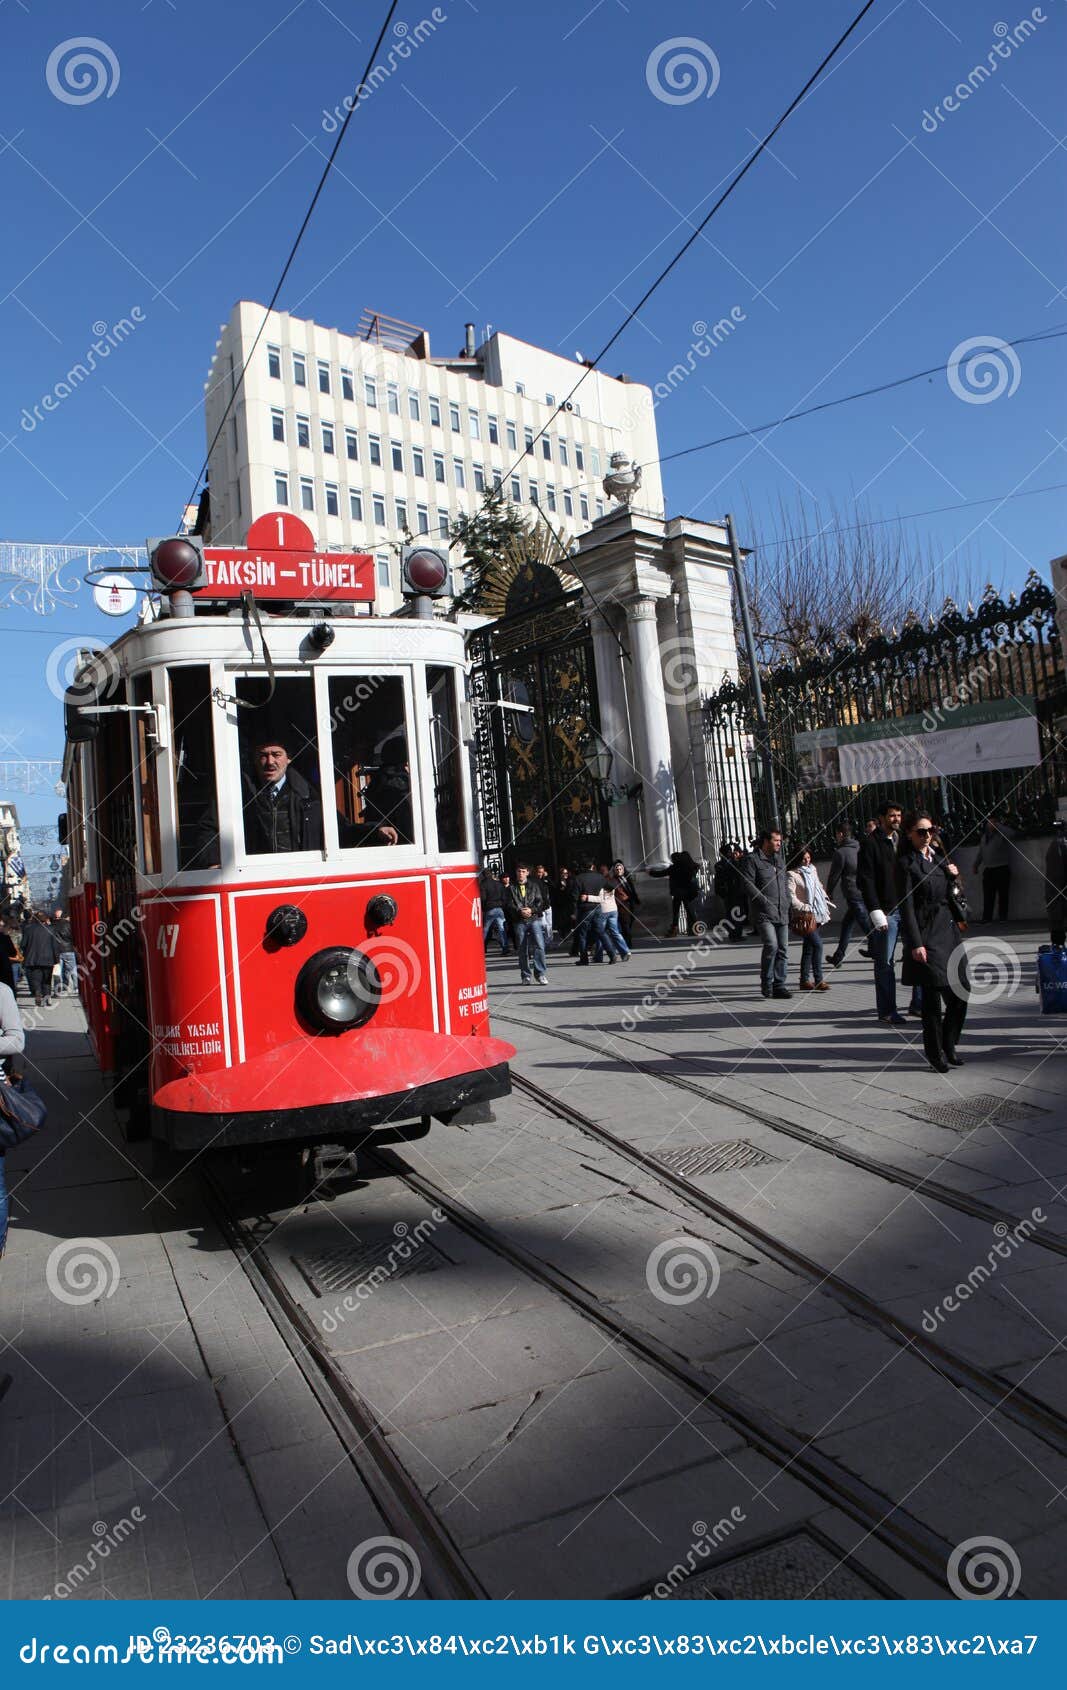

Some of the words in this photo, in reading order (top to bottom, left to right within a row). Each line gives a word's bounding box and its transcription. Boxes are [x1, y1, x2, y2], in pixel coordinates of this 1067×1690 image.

[275, 516, 285, 546] 1
[205, 556, 276, 586] TAKSİM
[298, 558, 363, 588] TÜNEL
[157, 924, 180, 958] 47
